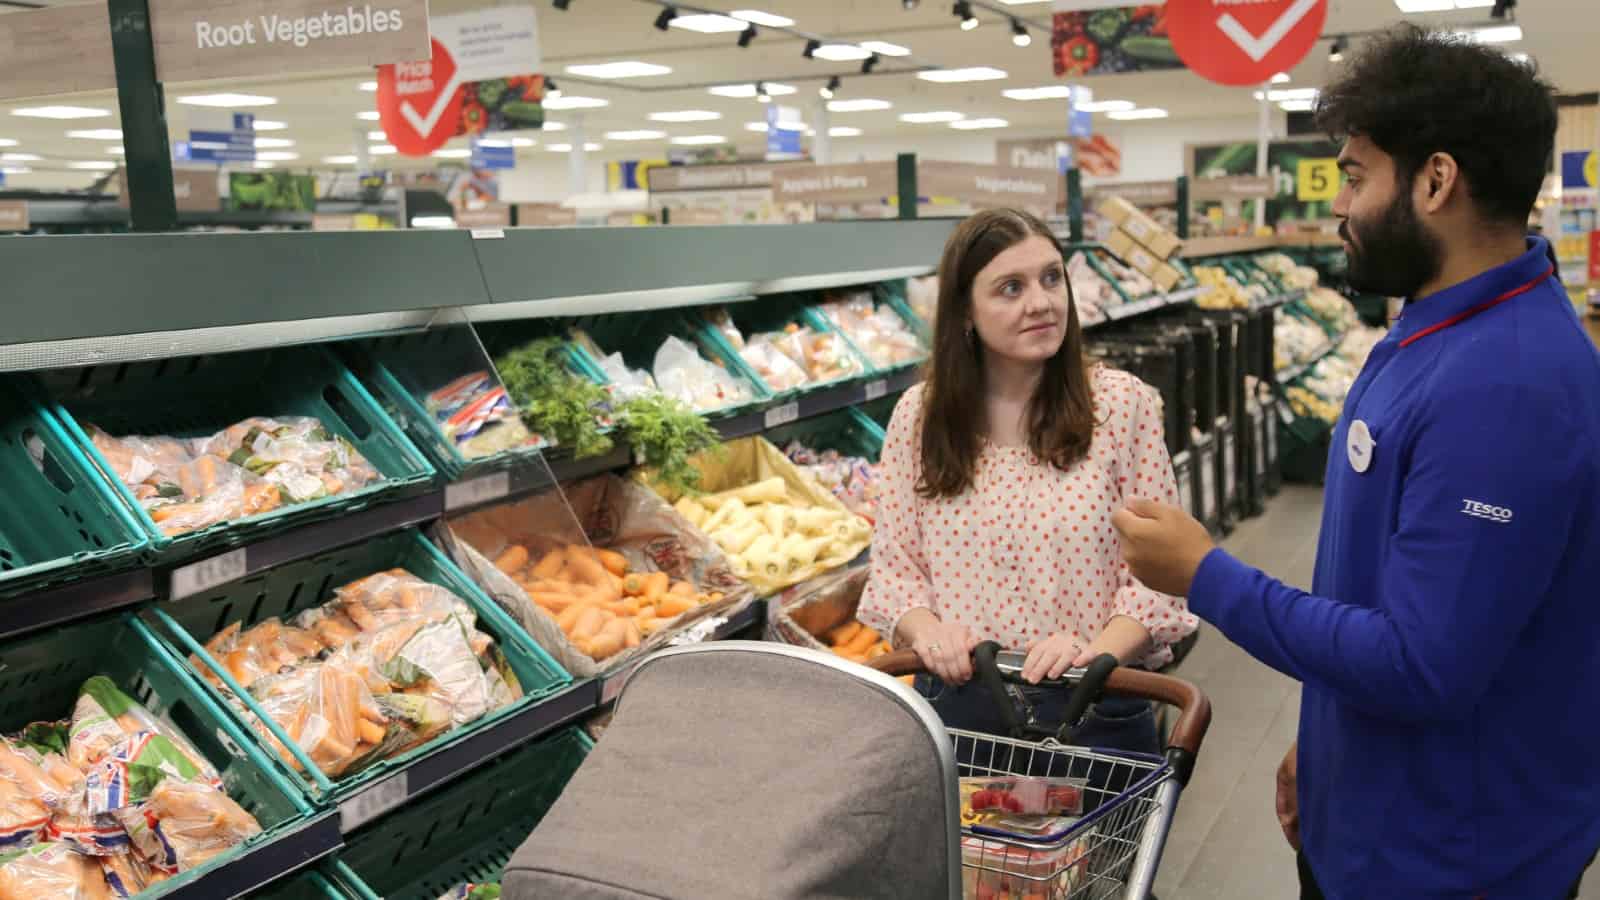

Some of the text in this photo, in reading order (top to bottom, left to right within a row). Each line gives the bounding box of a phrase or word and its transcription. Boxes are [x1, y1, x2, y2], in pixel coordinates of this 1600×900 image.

[195, 5, 402, 48] Root Vegetables
[1311, 165, 1328, 192] 5
[1462, 499, 1512, 519] TESCO
